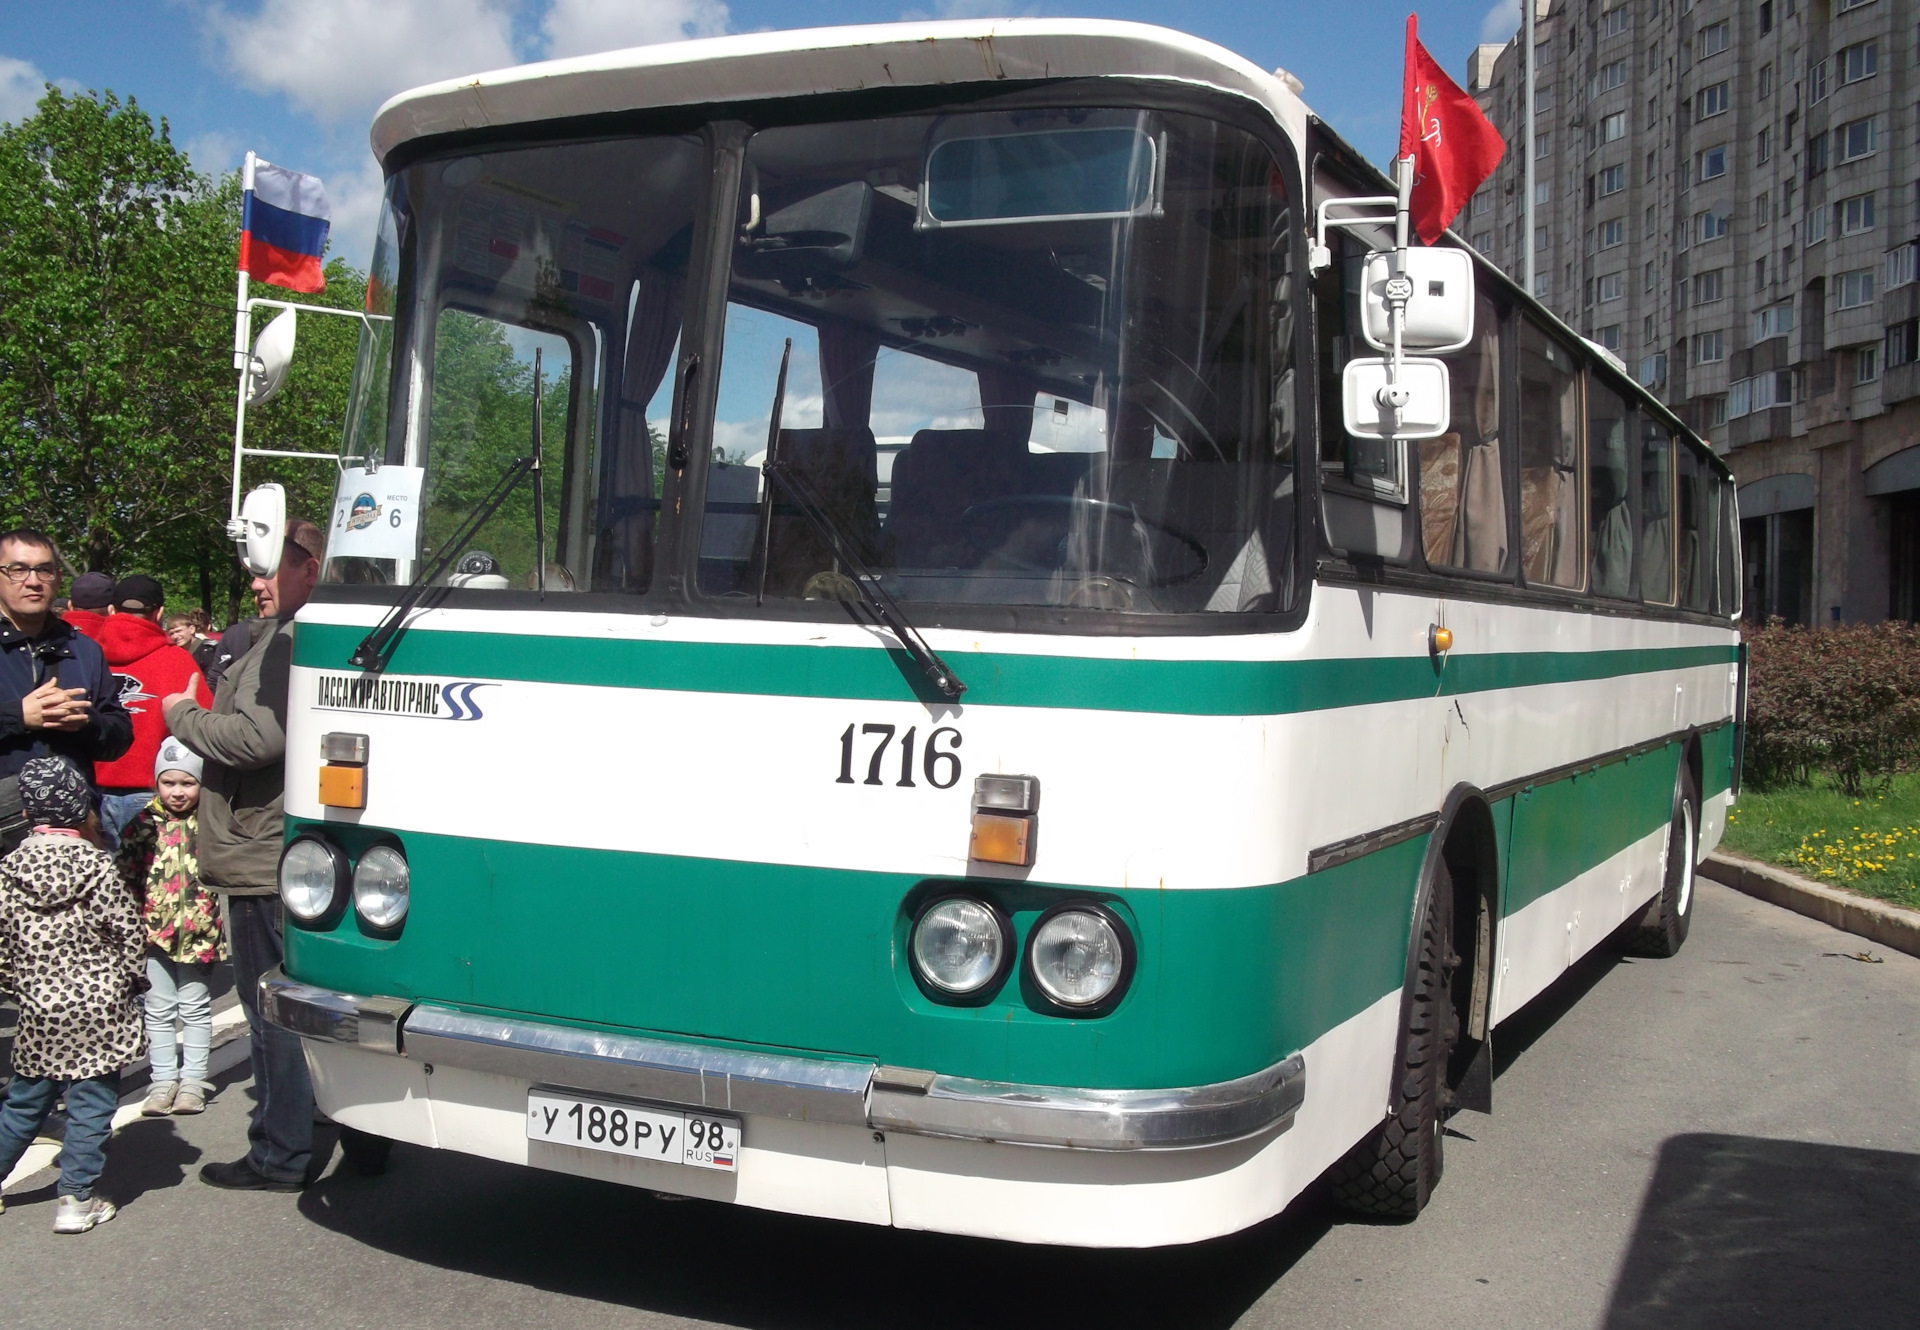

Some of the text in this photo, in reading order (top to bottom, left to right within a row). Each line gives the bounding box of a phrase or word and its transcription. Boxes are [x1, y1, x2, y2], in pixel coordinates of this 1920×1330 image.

[337, 509, 345, 528] 2
[390, 509, 402, 528] 6
[317, 675, 440, 715] ПАССАЖИРАВТОТРАНС
[835, 722, 963, 790] 1716
[689, 1119, 725, 1152] 98
[686, 1149, 713, 1163] RUS
